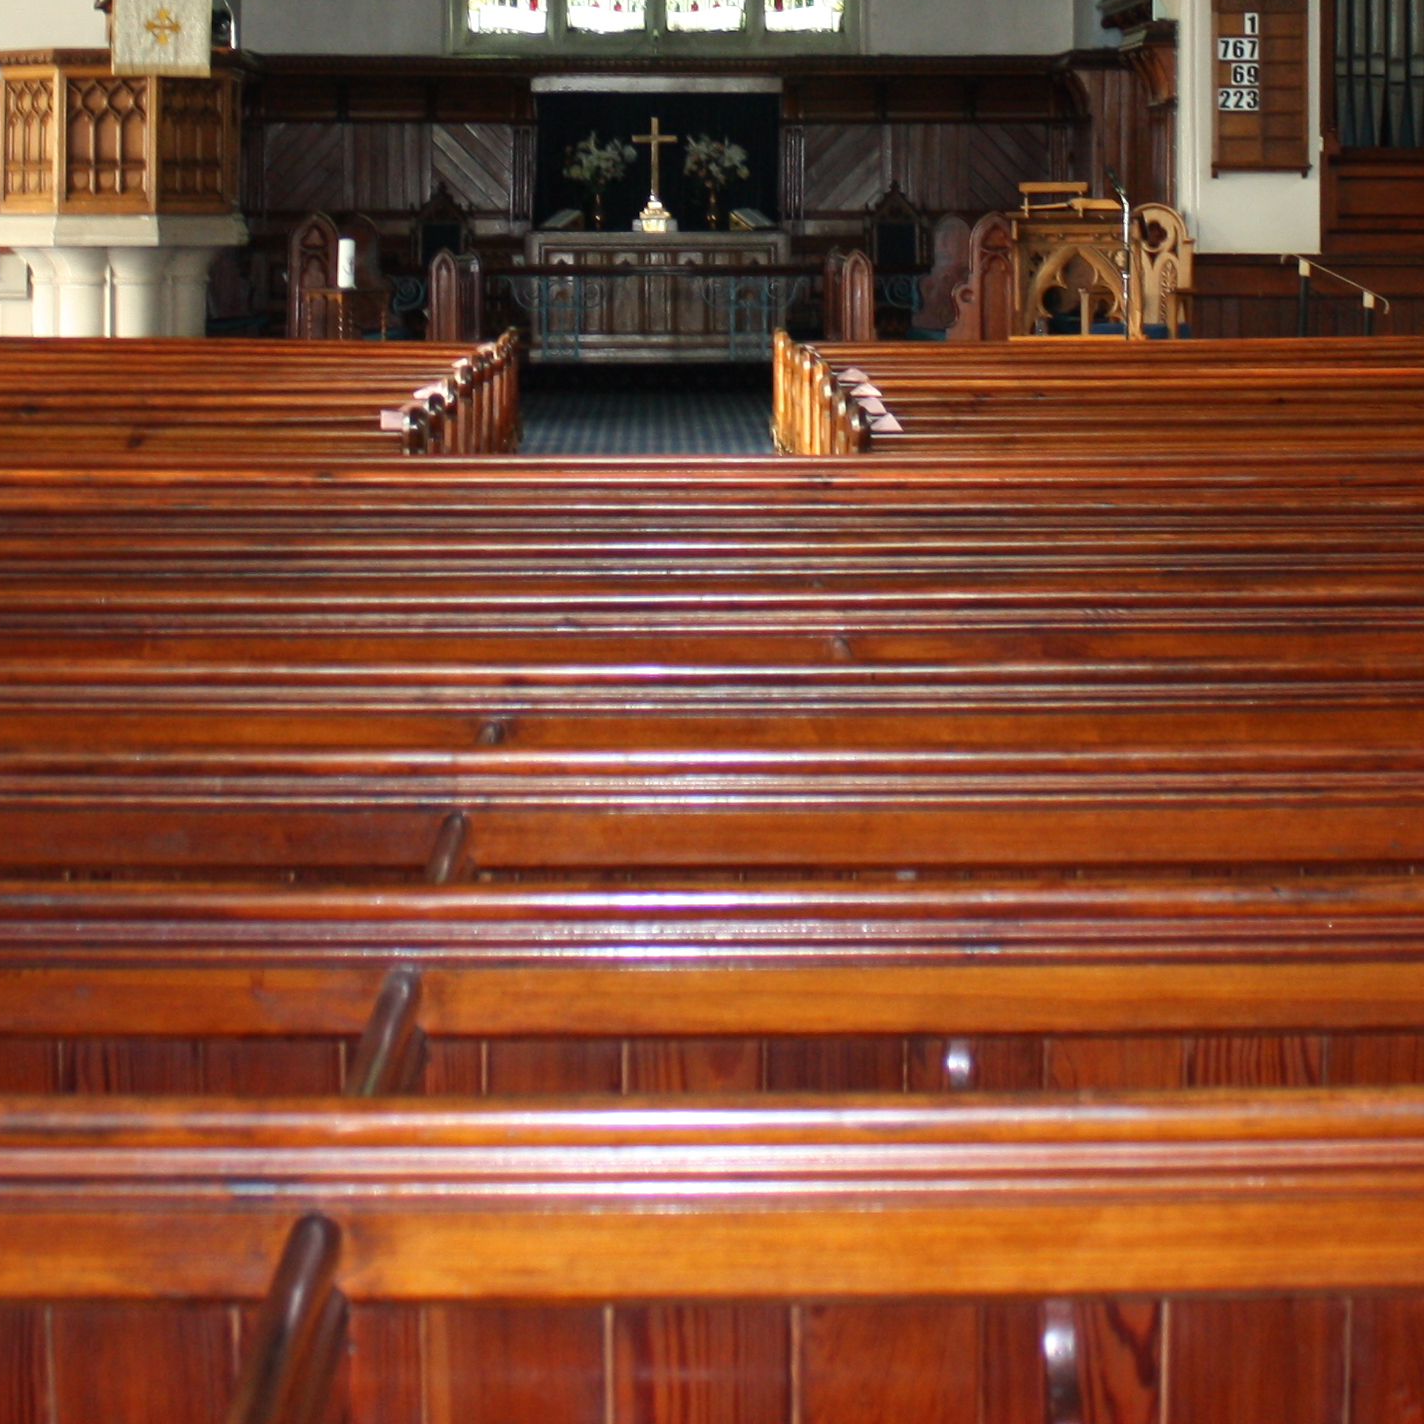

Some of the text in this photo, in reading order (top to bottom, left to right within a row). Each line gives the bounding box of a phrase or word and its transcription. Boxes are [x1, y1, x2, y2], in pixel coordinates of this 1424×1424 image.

[1247, 15, 1256, 34] 1
[1219, 40, 1257, 58] 767
[1233, 65, 1259, 84] 69
[1219, 90, 1258, 109] 223
